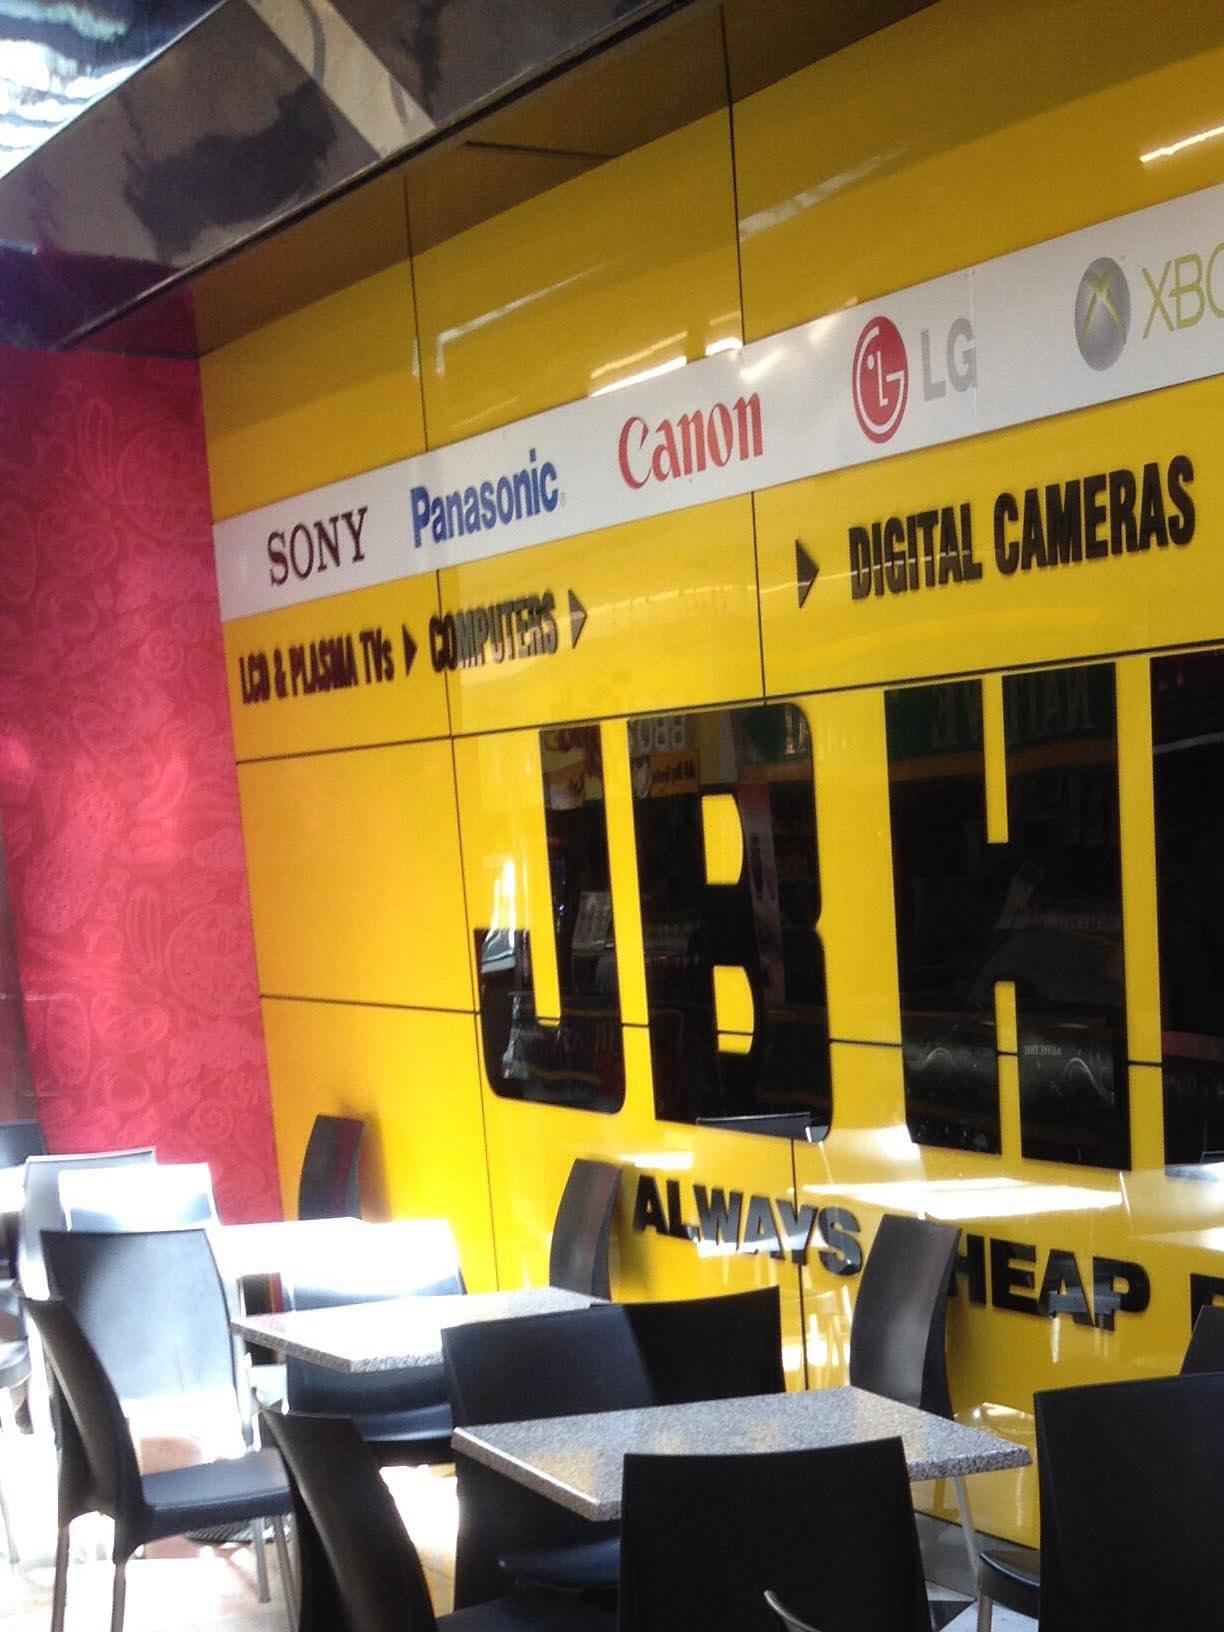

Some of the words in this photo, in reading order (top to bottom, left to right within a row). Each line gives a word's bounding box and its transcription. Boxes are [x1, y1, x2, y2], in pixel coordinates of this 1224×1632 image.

[920, 317, 978, 401] LG
[618, 393, 764, 491] Canon
[267, 506, 368, 586] SONY
[411, 449, 559, 548] Panasonic
[849, 503, 983, 600] DIGITAL
[993, 455, 1196, 576] CAMERAS
[239, 646, 270, 704] LCD
[274, 646, 291, 699] &
[289, 632, 359, 698] PLASMA
[360, 624, 395, 686] TVs
[429, 588, 558, 673] COMPUTERS
[474, 702, 833, 1143] JB
[632, 1173, 863, 1277] ALWAYS
[950, 1233, 1151, 1332] HEAP
